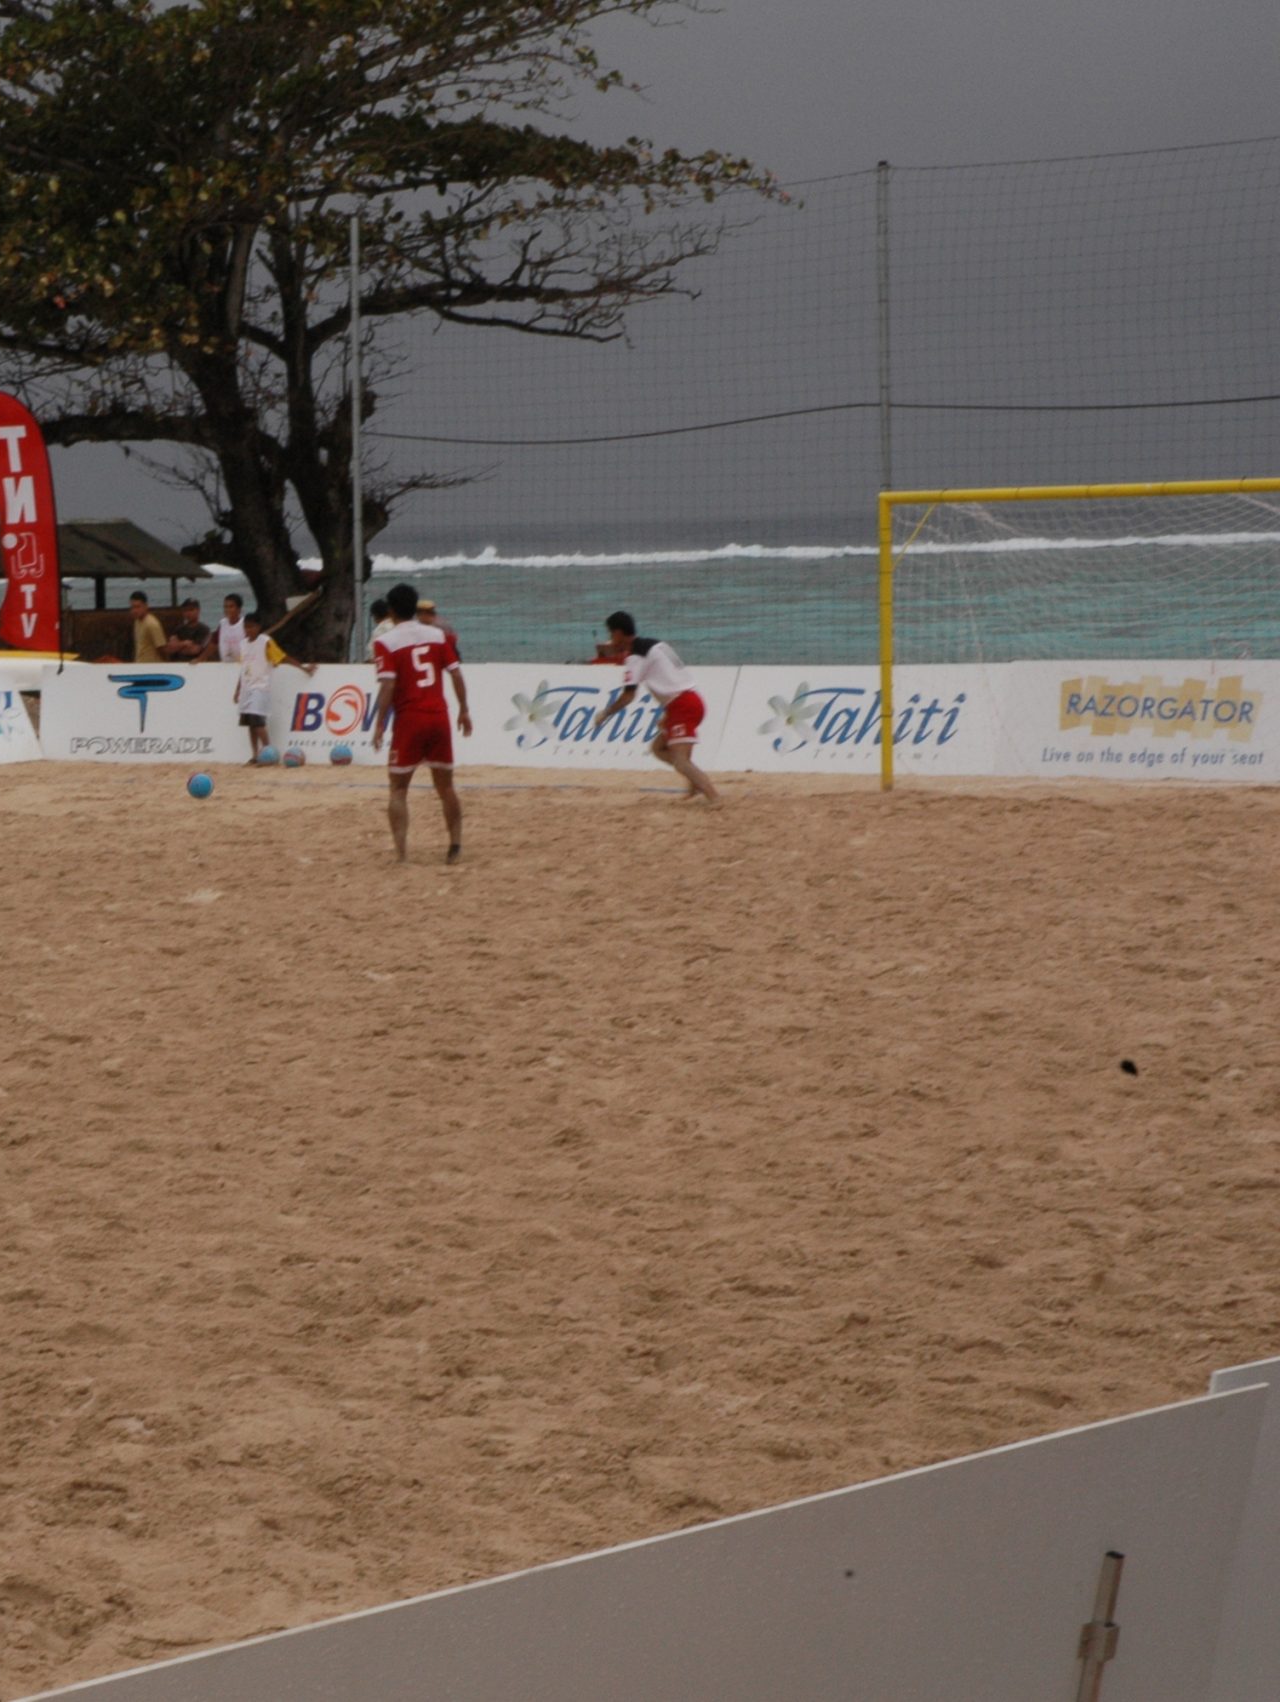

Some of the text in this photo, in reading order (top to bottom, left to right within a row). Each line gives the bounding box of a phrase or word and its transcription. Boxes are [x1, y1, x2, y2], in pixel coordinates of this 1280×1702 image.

[411, 645, 435, 688] 5
[517, 686, 666, 748] Tahit
[1066, 693, 1254, 724] RAZORGATOR
[70, 736, 215, 755] POWERADE
[1041, 747, 1264, 767] Live on the edge of your seat
